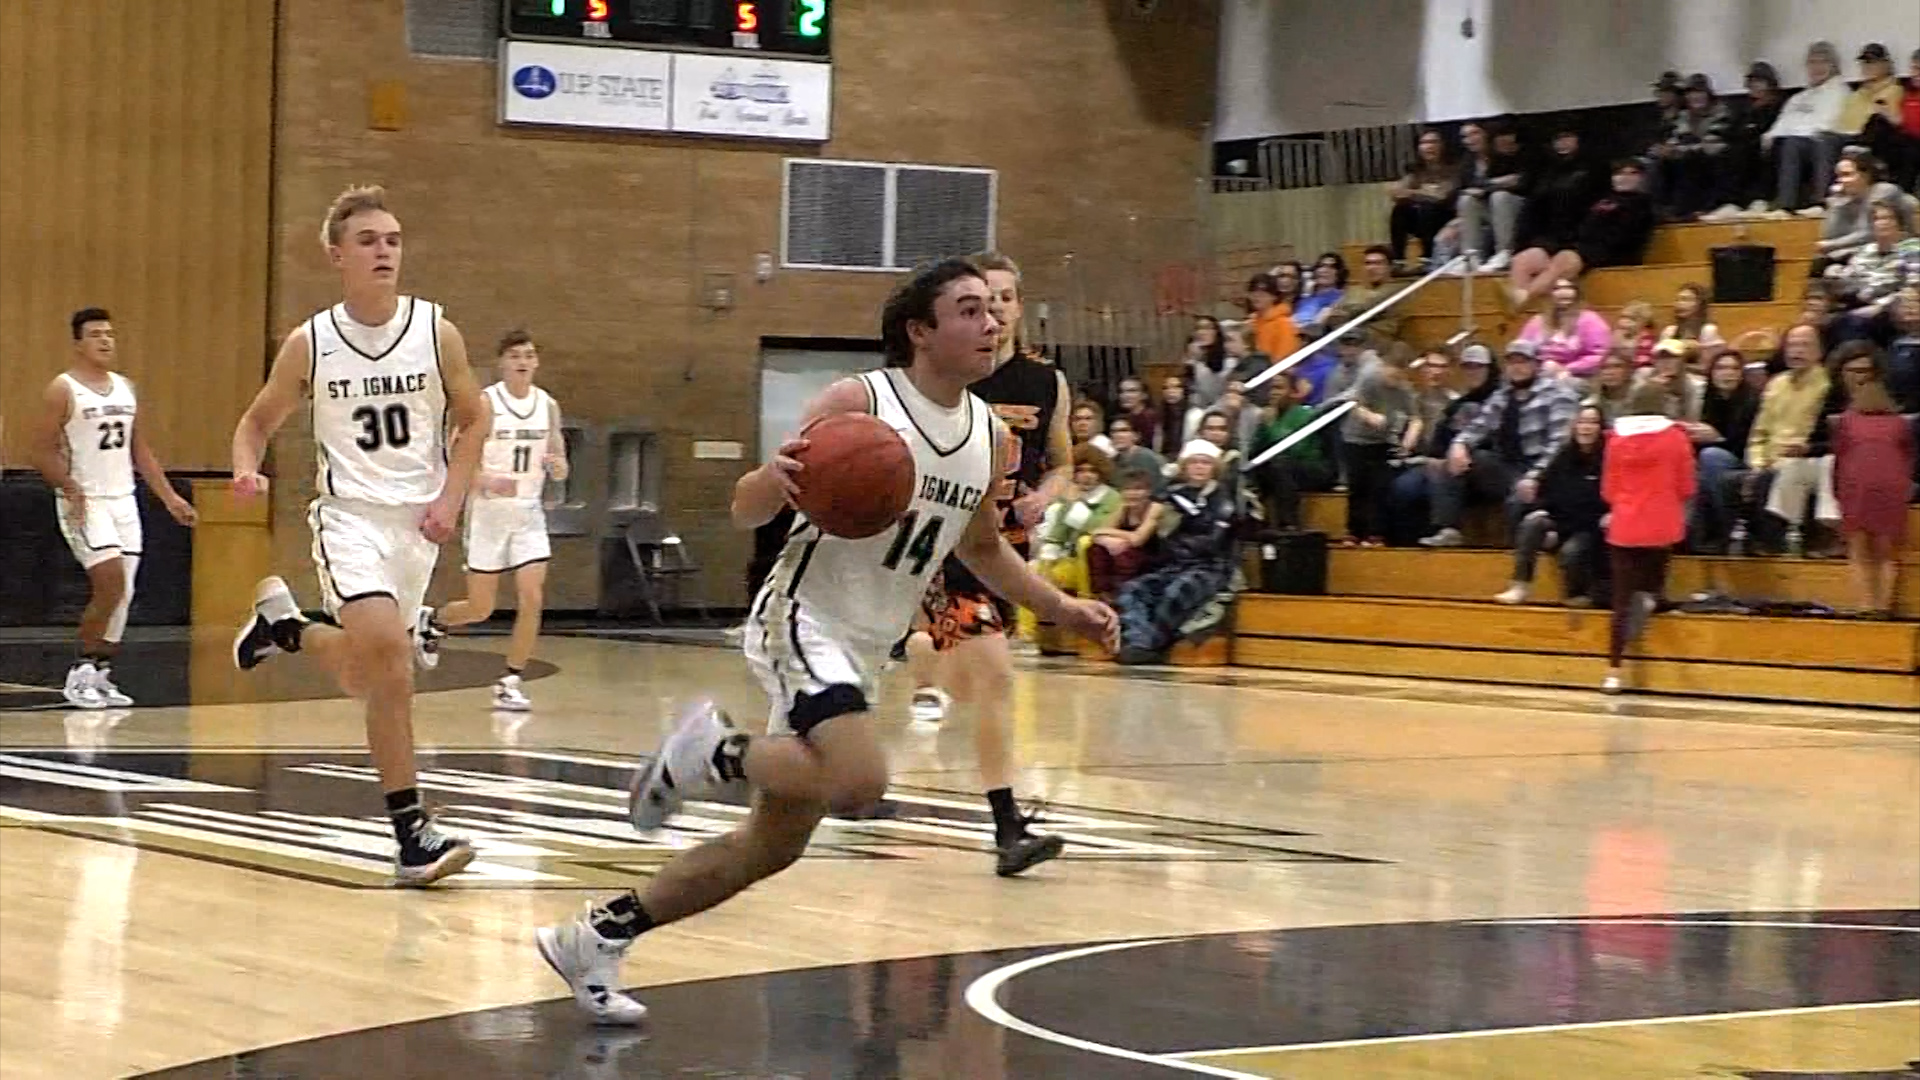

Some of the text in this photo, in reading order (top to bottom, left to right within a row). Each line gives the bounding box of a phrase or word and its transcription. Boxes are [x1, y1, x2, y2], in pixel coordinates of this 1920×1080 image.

[737, 3, 758, 30] 5
[799, 0, 826, 36] 2
[327, 373, 427, 399] ST. IGNACE
[97, 421, 125, 450] 23
[352, 403, 411, 452] 30
[512, 445, 532, 474] 11
[882, 510, 944, 576] 14
